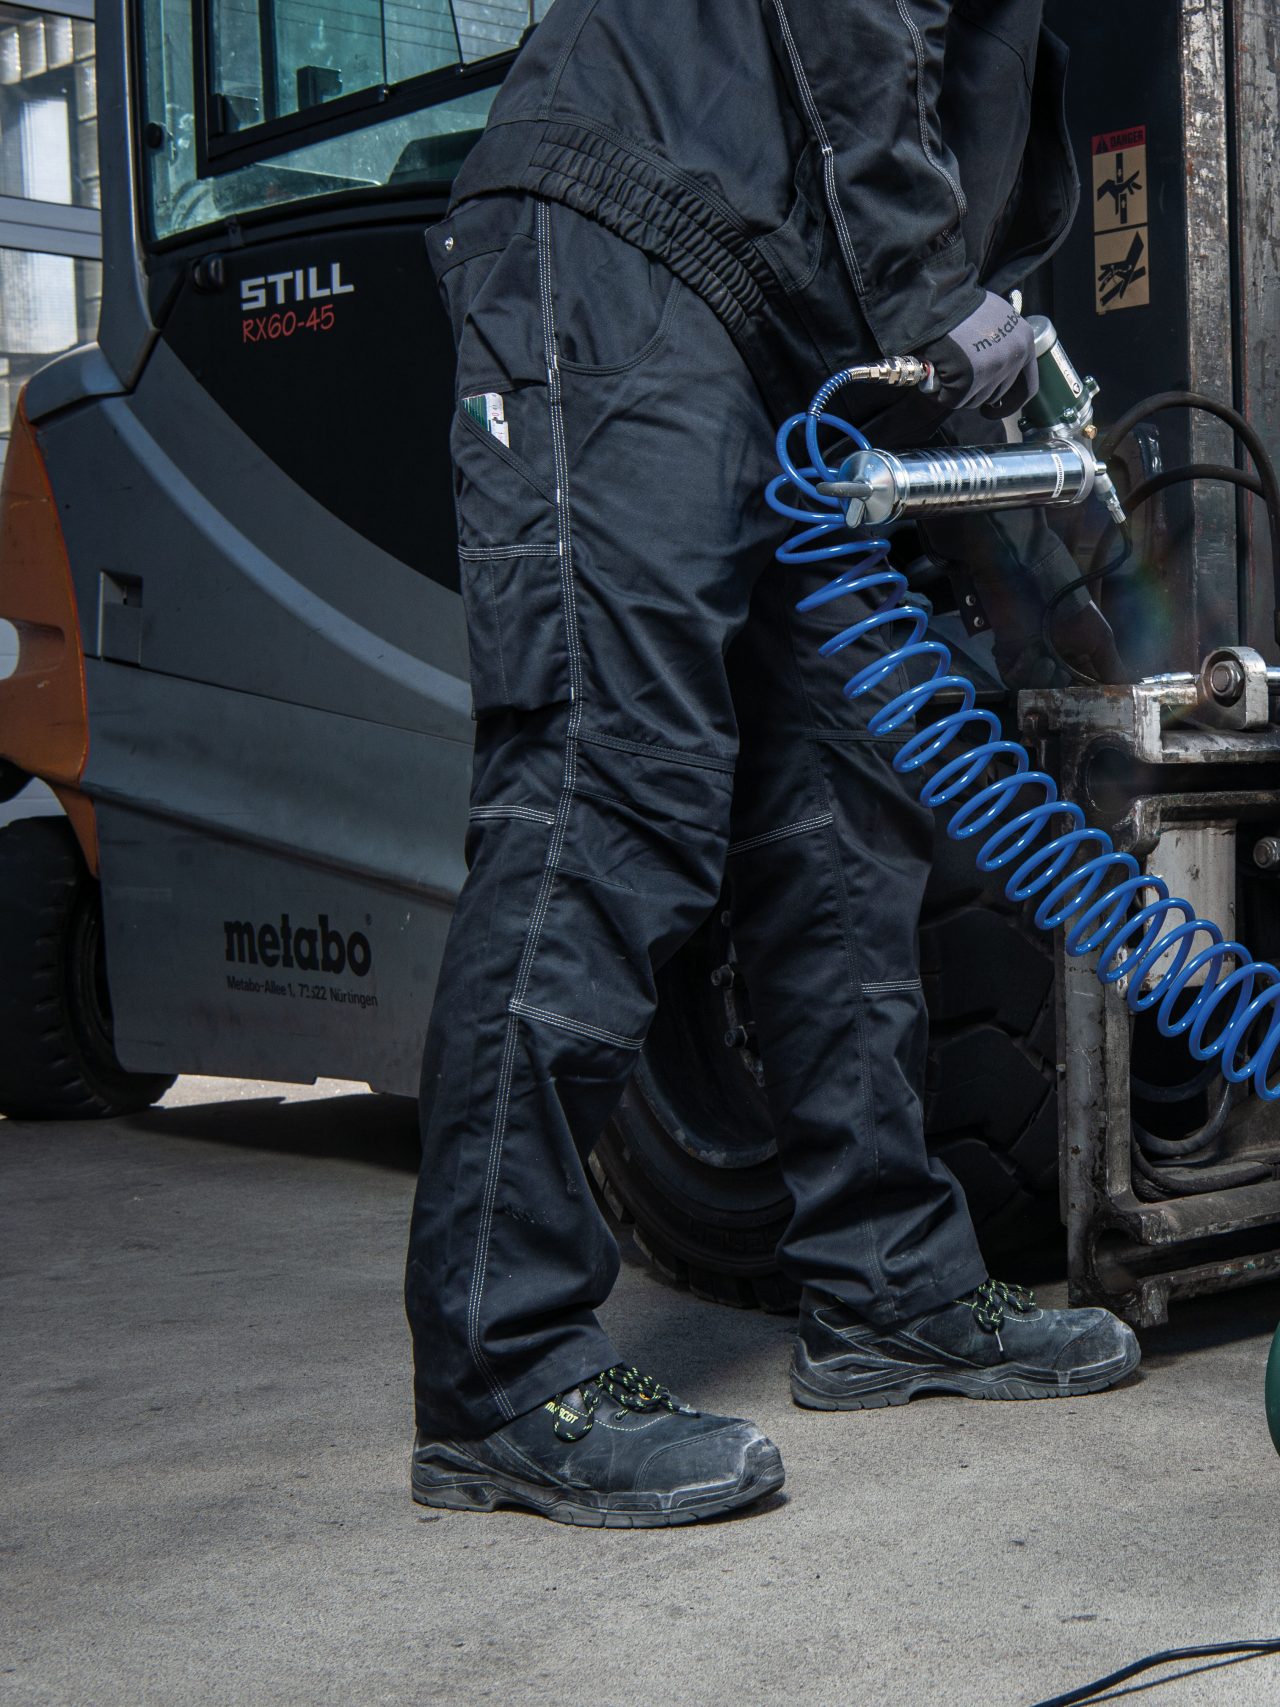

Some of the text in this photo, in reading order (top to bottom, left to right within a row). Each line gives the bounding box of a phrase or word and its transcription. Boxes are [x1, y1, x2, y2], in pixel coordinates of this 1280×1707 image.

[1110, 129, 1143, 147] DANGER
[240, 262, 354, 311] STILL
[242, 304, 335, 343] RX60-45
[224, 914, 371, 977] metabo
[226, 975, 287, 996] Metabo-Allee
[329, 987, 378, 1009] Nürtingen
[544, 1401, 579, 1424] MSCOT
